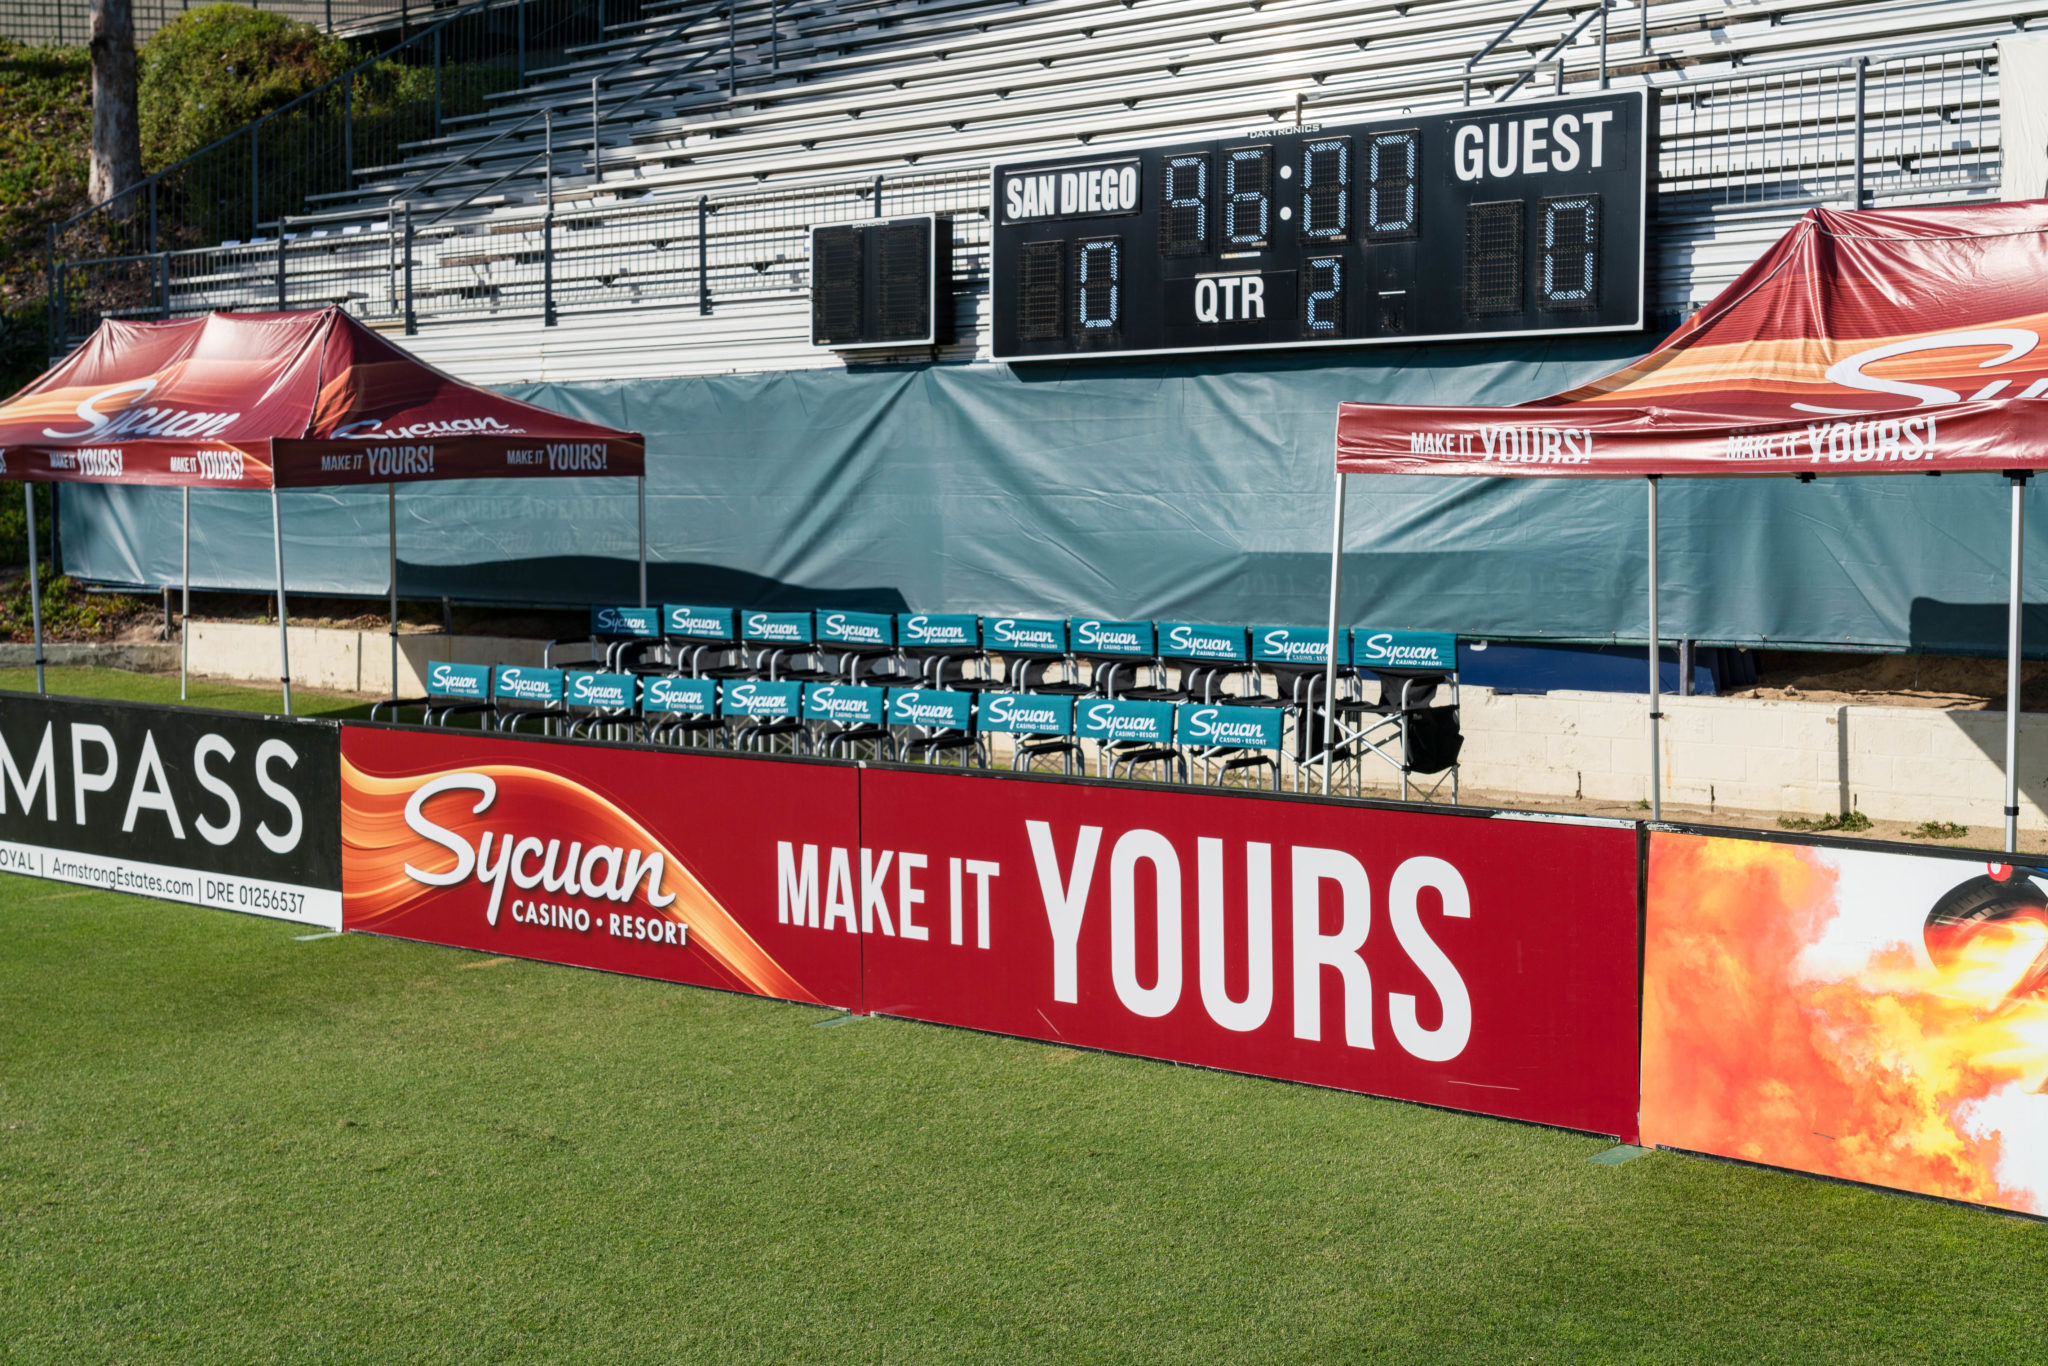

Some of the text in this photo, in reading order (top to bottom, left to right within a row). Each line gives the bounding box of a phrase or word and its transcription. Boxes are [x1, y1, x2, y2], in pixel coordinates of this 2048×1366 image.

[1249, 124, 1320, 139] DAKTRONICS
[1454, 110, 1613, 181] GUEST
[1006, 166, 1137, 219] SAN DIEGO
[1544, 200, 1594, 300] 0
[1080, 241, 1118, 328] 0
[1194, 276, 1266, 323] QTR
[1307, 259, 1340, 330] 2
[42, 379, 241, 444] Sycuan
[1411, 425, 1592, 464] MAKE IT YOURS!
[1725, 416, 1937, 463] MAKE IT YOURS!
[77, 448, 122, 477] YOURS!
[170, 450, 244, 480] MAKE IT YOURS!
[321, 445, 434, 476] MAKE IT YOURS!
[507, 444, 608, 471] MAKE IT YOURS!
[598, 609, 646, 633] Sycuan
[672, 608, 721, 634] Sycuan
[748, 614, 799, 639] Sycuan
[826, 614, 880, 640] Sycuan
[907, 616, 964, 644] Sycuan
[994, 620, 1054, 647] Sycuan
[1078, 621, 1138, 649] Sycuan
[1170, 627, 1233, 656] Sycuan
[1264, 630, 1329, 660] Sycuan
[1366, 633, 1438, 665] Sycuan
[432, 666, 477, 693] Sycuan
[500, 669, 550, 696] Sycuan
[574, 676, 623, 704] Sycuan
[650, 680, 702, 709] Sycuan
[730, 684, 786, 714] Sycuan
[811, 687, 869, 718] Sycuan
[894, 692, 953, 723] Sycuan
[988, 697, 1056, 730] Sycuan
[1086, 703, 1157, 738] Sycuan
[1189, 709, 1264, 743] Sycuan
[0, 720, 303, 854] MPASS
[404, 772, 676, 926] Sycuan
[0, 849, 304, 914] OYAL ArmstrongEstates.com DRE 01256537
[512, 900, 689, 945] CASINO RESORT
[777, 820, 1472, 1062] MAKE IT YOURS
